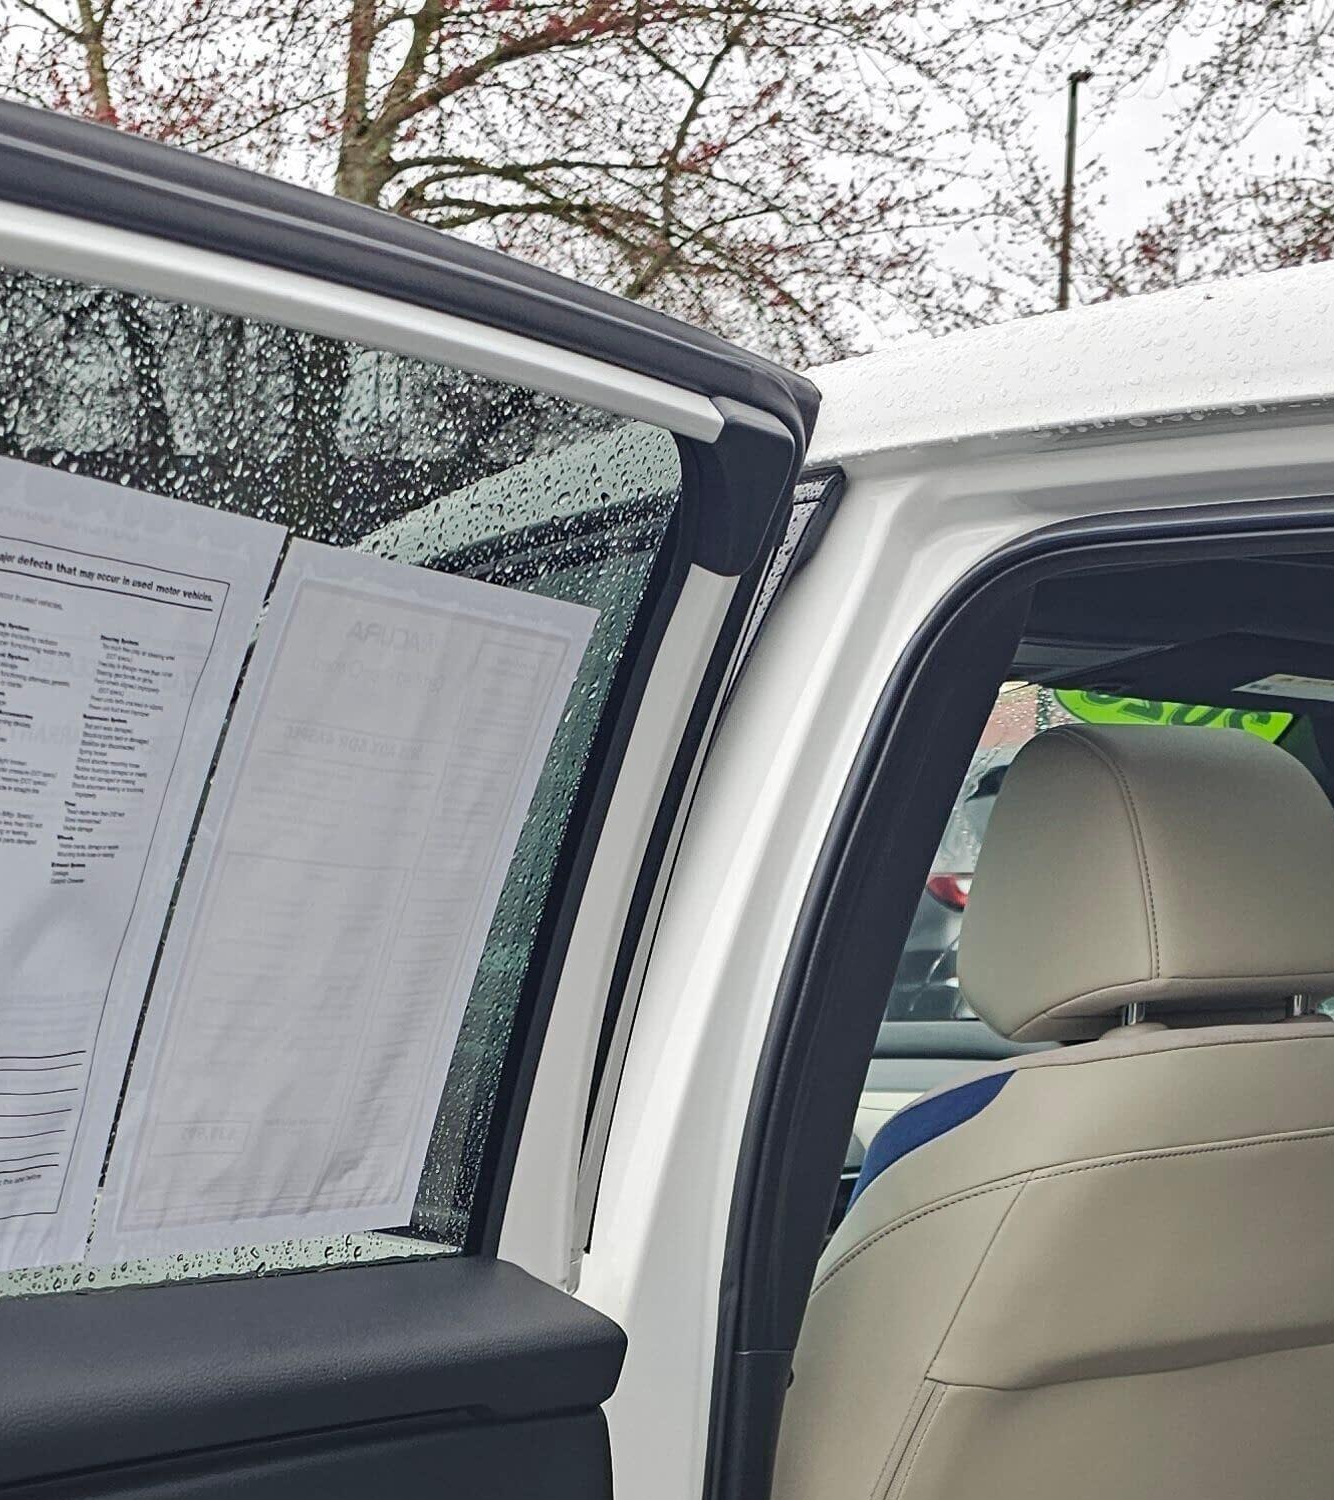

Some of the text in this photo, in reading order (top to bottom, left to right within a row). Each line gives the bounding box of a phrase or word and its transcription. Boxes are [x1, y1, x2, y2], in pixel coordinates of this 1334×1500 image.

[17, 555, 53, 571] defects
[57, 564, 77, 575] that
[79, 570, 94, 580] may
[96, 573, 120, 583] occur
[122, 577, 130, 585] in
[132, 579, 153, 590] used
[156, 584, 180, 595] motor
[182, 589, 214, 601] vehicles.
